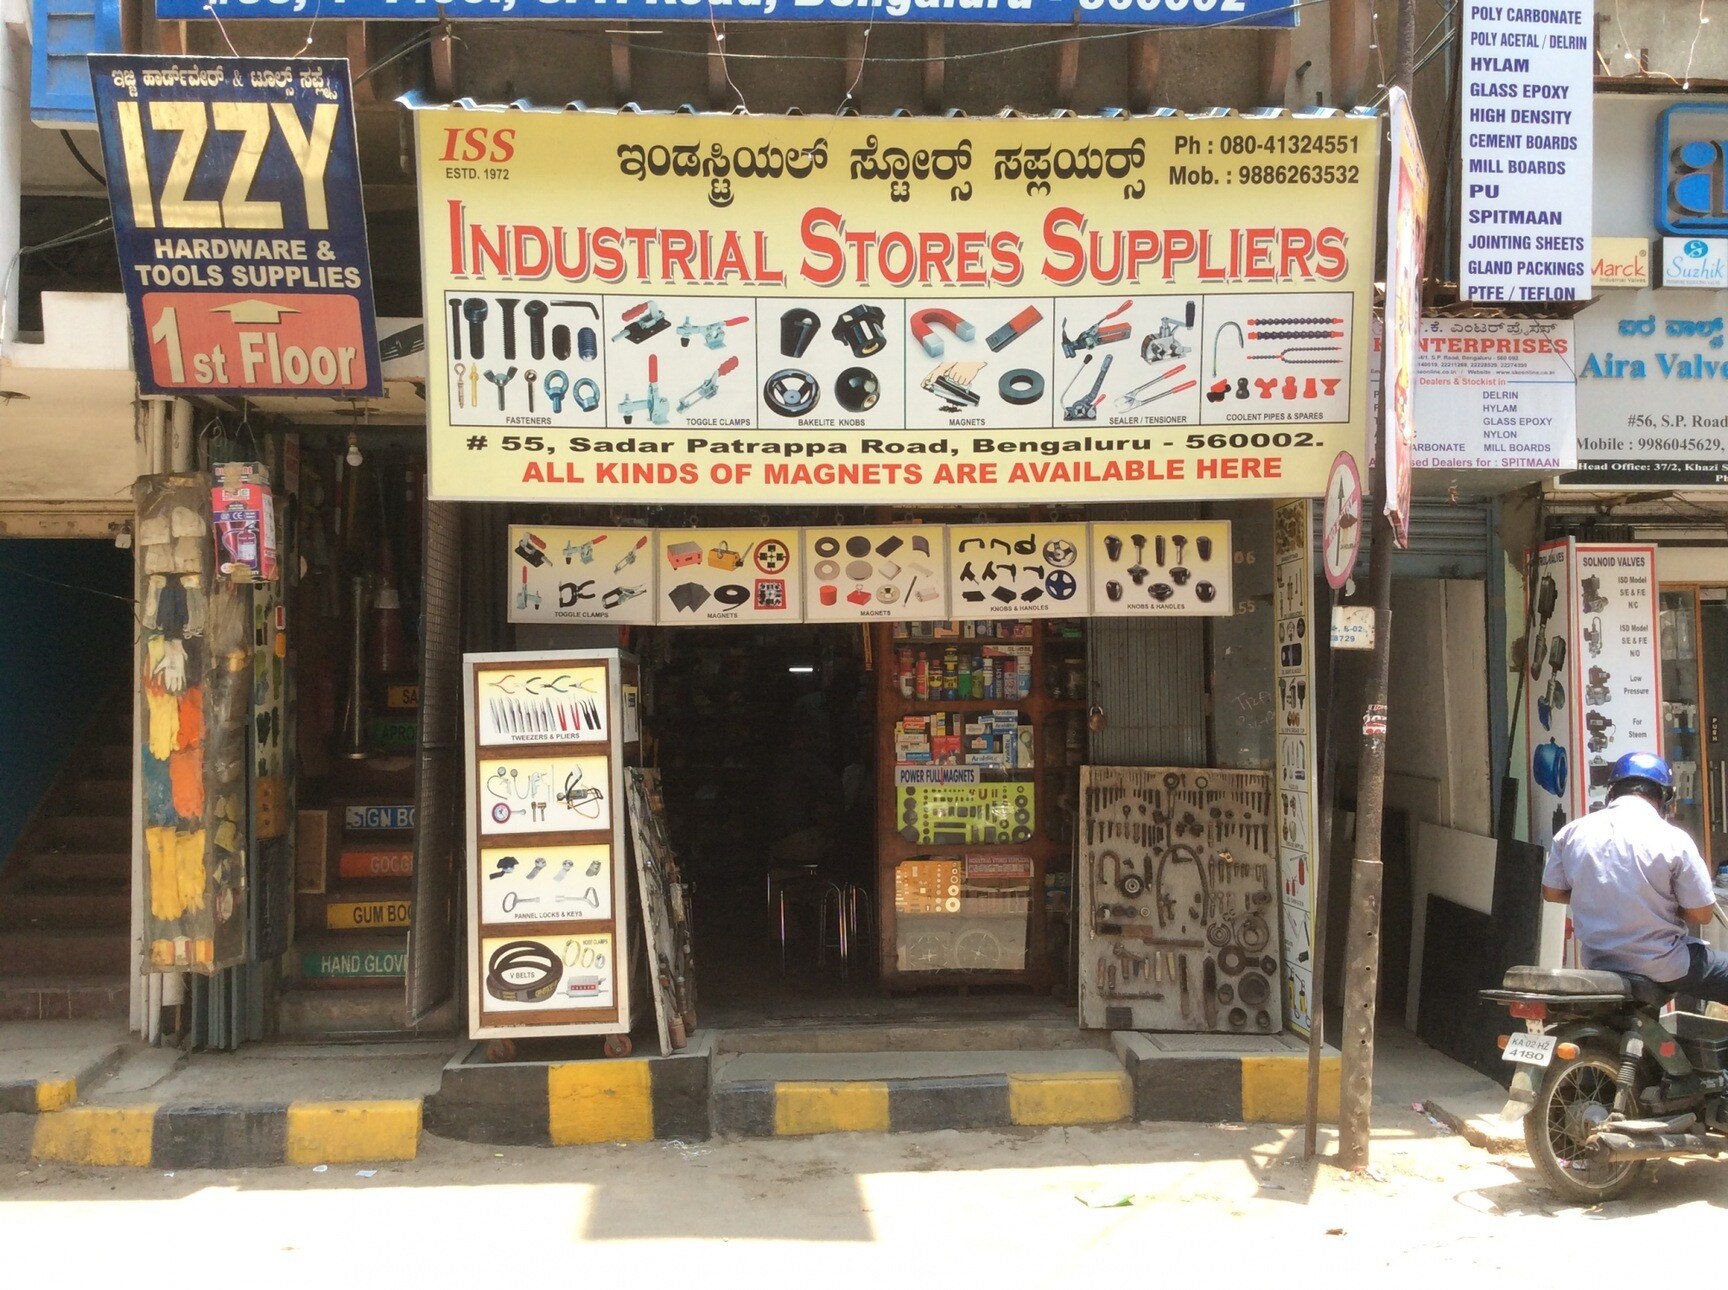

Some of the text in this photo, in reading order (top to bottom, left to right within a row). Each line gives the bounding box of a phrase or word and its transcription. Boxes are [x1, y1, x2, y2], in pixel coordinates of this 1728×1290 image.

[1471, 6, 1582, 25] POLY CARBONATE
[1471, 31, 1588, 50] POLY ACETAL DELRIN
[1470, 57, 1530, 73] HYLAM
[233, 69, 244, 87] &
[1470, 82, 1569, 100] GLASS EPOXY
[1469, 108, 1572, 125] HIGH DENSITY
[439, 126, 516, 163] ISS
[1174, 135, 1359, 155] Ph 080-41324551
[1469, 134, 1578, 151] CEMENT BOARDS
[116, 101, 339, 230] IZZY
[1469, 159, 1566, 175] MILL BOARDS
[445, 167, 510, 180] ESTD. 1972
[1169, 165, 1360, 185] Mob. 9886263532
[1469, 184, 1500, 199] PU
[1468, 210, 1562, 225] SPITMAAN
[154, 239, 336, 261] HARDWARE &
[447, 199, 1349, 288] INDUSTRIAL STORES SUPPLIERS
[1468, 235, 1585, 251] JOINTING SHEETS
[1468, 260, 1585, 277] GLAND PACKINGS
[1666, 255, 1724, 281] Suzhik
[135, 264, 362, 288] TOOLS SUPPLIES
[1468, 286, 1576, 301] PTFE TEFLON
[1419, 337, 1569, 354] NTERPRISES
[239, 331, 358, 386] Floor
[1579, 352, 1647, 381] Aira
[1419, 377, 1451, 386] Dealers
[1453, 377, 1460, 385] &
[1462, 377, 1496, 386] Stockist
[1482, 390, 1519, 400] DELRIN
[1482, 404, 1518, 413] HYLAM
[506, 416, 552, 425] FASTENERS
[686, 418, 751, 427] TOGGLE CLAMPS
[798, 418, 866, 427] BAKELITE KNOBS
[948, 418, 986, 427] MAGNETS
[1109, 415, 1188, 425] SEALER TENSIONER
[1226, 413, 1263, 422] COOLENT
[1264, 413, 1286, 421] PIPES
[1294, 412, 1324, 421] SPARES
[1483, 417, 1553, 426] GLASS EPOXY
[1627, 414, 1728, 429] #56, S.P. Road
[1483, 430, 1518, 439] NYLON
[466, 432, 1324, 458] # 55, Sadar Patrappa Road, Bengaluru 560002.
[1412, 443, 1552, 452] ARBONATE MILL BOARDS
[1577, 437, 1725, 453] Mobile 9986045629,
[1432, 457, 1474, 467] Dealers
[1476, 457, 1492, 467] for
[1501, 458, 1561, 468] SPITMAAN
[1578, 462, 1608, 471] Head
[1611, 462, 1651, 471] Office:
[1685, 463, 1718, 472] Khazi
[521, 457, 1283, 485] ALL KINDS OF MAGNETS ARE AVAILABLE HERE
[1582, 556, 1646, 567] SOLNOID VALVES
[1631, 624, 1649, 632] Model
[1630, 674, 1642, 682] Low
[1624, 687, 1649, 695] Pressure
[1632, 718, 1642, 726] For
[556, 732, 580, 740] PLIERS
[900, 769, 975, 783] POWER FULL MAGNETS
[352, 808, 393, 828] SIGN
[353, 905, 383, 924] GUM
[321, 953, 409, 974] HAND GLOV
[1511, 1038, 1524, 1046] KA
[1525, 1040, 1537, 1048] 02
[1509, 1049, 1545, 1061] 4180
